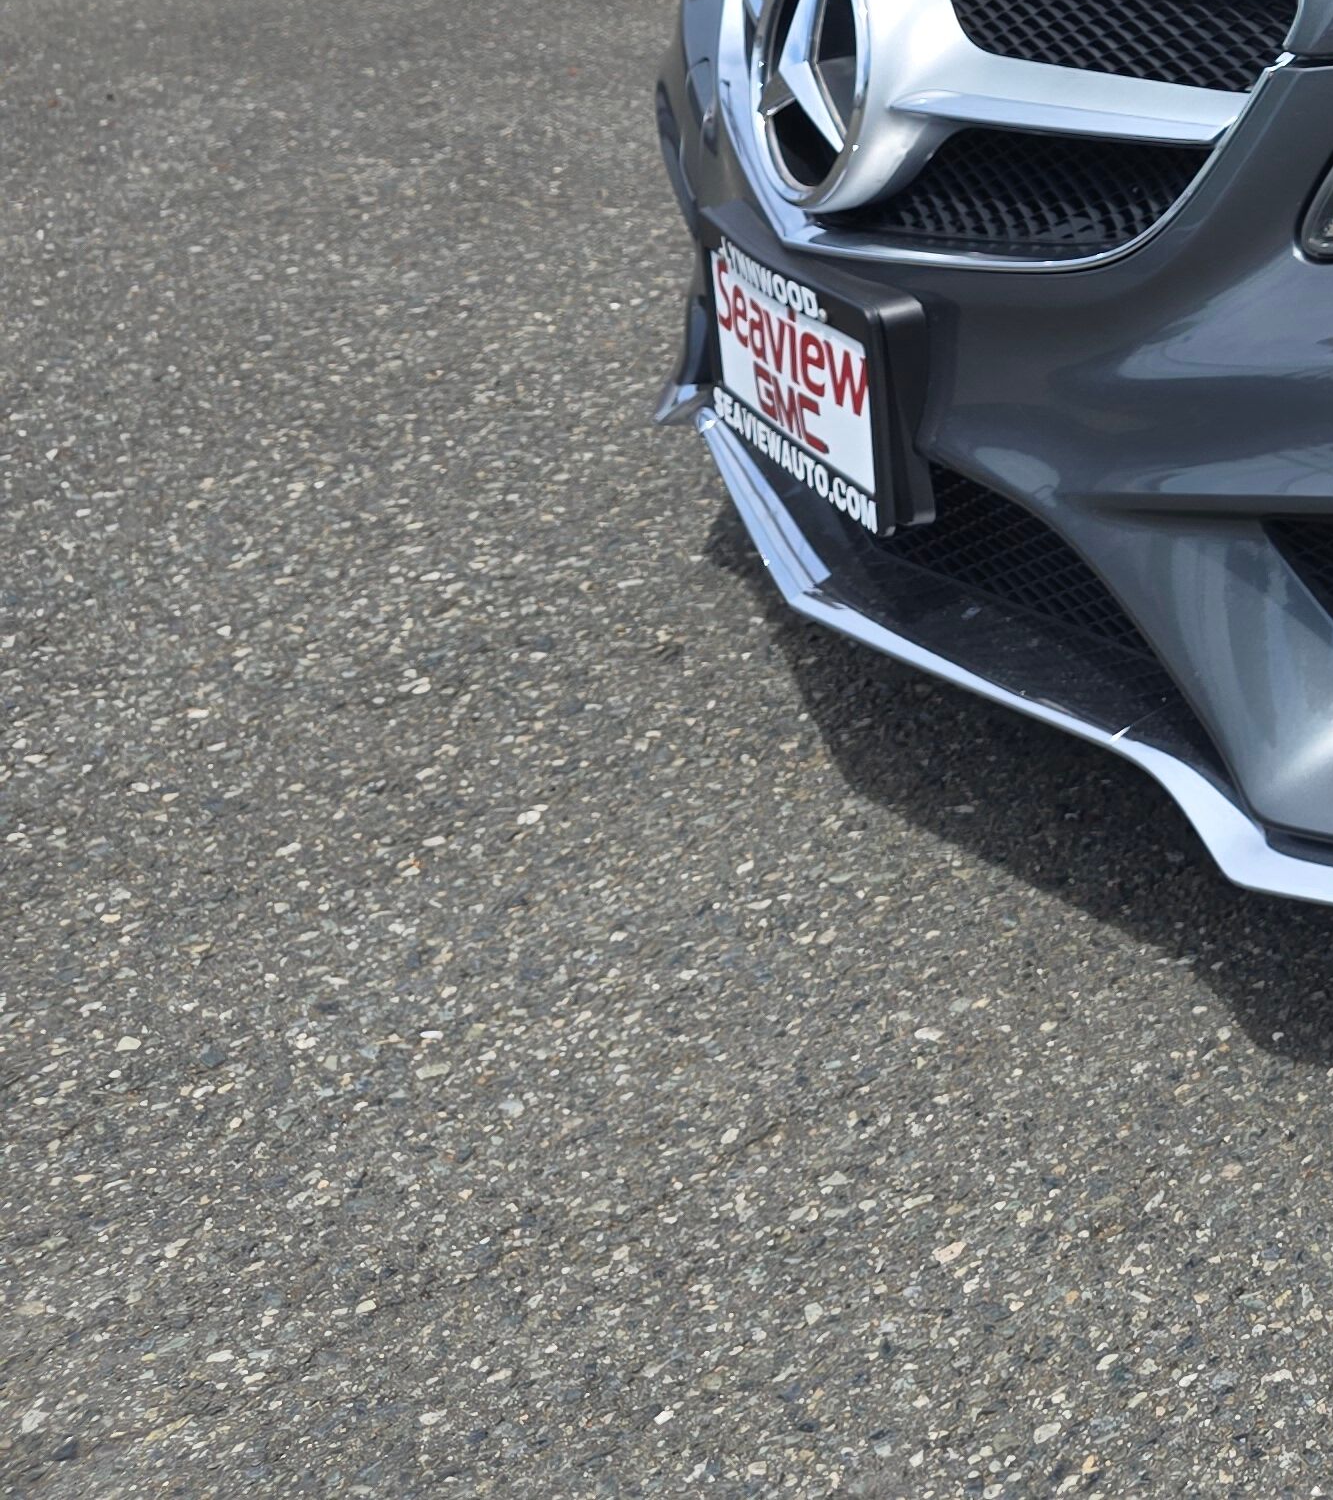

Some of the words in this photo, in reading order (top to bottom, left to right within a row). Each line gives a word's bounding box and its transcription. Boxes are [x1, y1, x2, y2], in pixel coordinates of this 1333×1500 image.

[717, 257, 868, 417] Seaview
[720, 236, 819, 319] LYNNWOOD
[713, 387, 878, 534] SEAVIEWAUTO.COM
[753, 360, 830, 455] GMC
